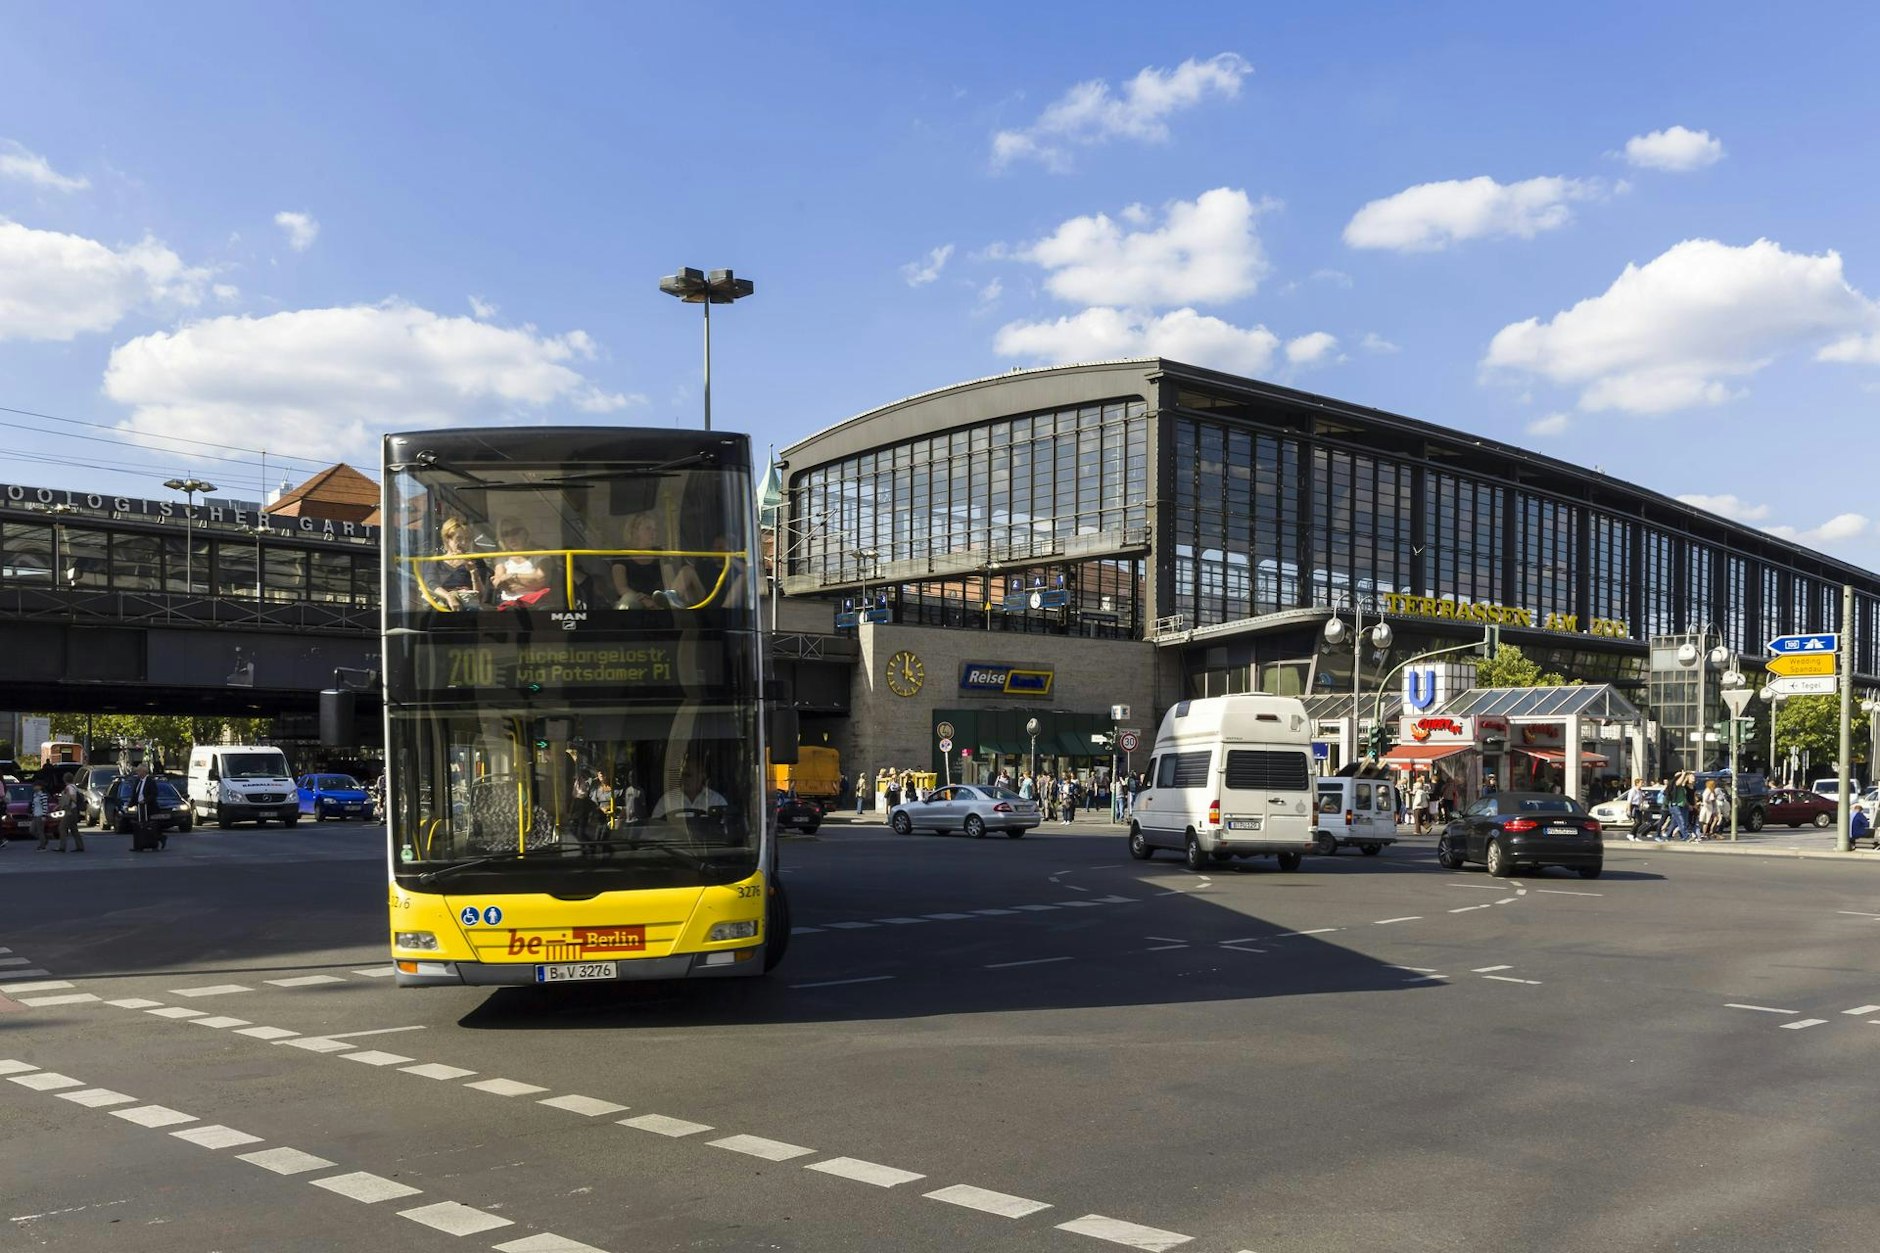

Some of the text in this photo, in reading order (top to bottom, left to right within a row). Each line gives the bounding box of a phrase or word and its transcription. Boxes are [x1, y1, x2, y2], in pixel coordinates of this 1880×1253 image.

[551, 612, 587, 620] MAN
[1384, 592, 1628, 638] TERRASSEN AM ZOO
[448, 648, 492, 686] 200
[1790, 658, 1821, 666] Wedding
[517, 667, 546, 682] via
[552, 665, 648, 682] Potsdamer
[969, 670, 1005, 684] Reise
[1408, 670, 1435, 709] U
[1801, 681, 1821, 690] Tegel
[1124, 737, 1135, 747] 30
[737, 885, 761, 898] 3276
[507, 929, 639, 956] be Berlin
[550, 964, 611, 979] B V 3276
